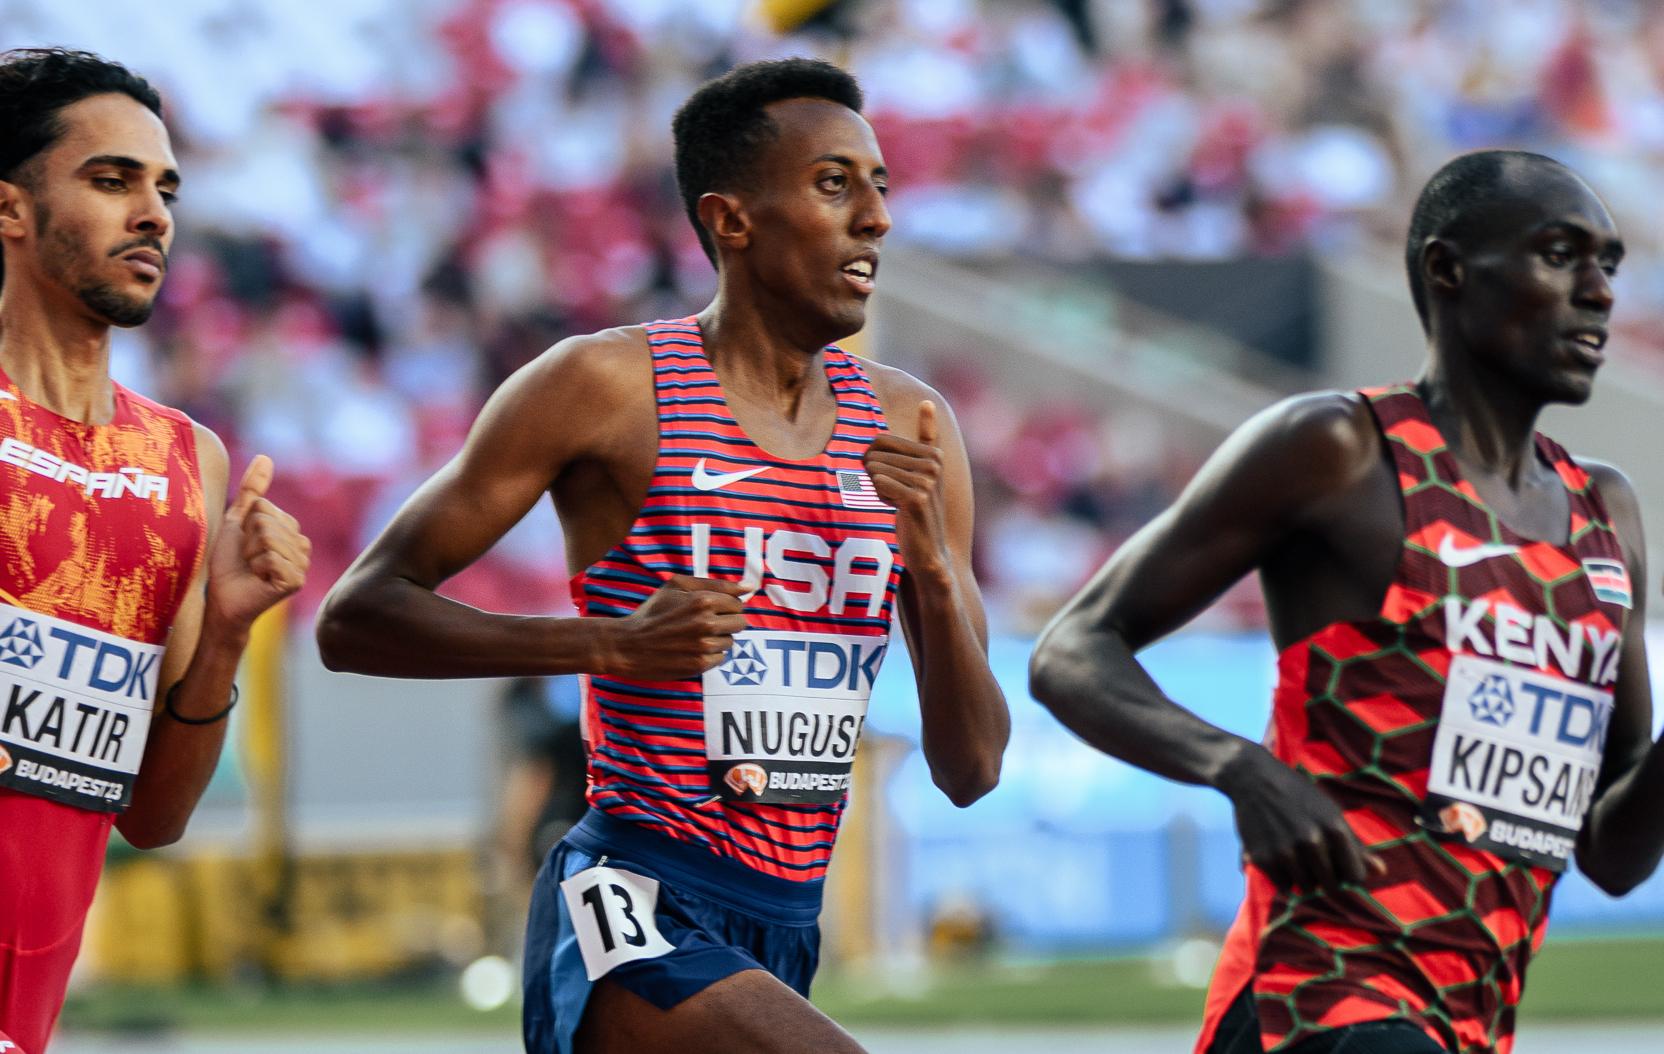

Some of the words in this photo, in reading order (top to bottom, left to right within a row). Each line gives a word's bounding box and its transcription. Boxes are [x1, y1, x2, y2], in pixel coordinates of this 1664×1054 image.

[0, 437, 169, 501] ESPAÑA
[691, 523, 893, 617] USA
[50, 627, 157, 700] TDK
[766, 639, 888, 690] TDK
[1, 684, 129, 763] KATIR
[721, 711, 865, 758] NUGUS
[582, 884, 647, 953] 13
